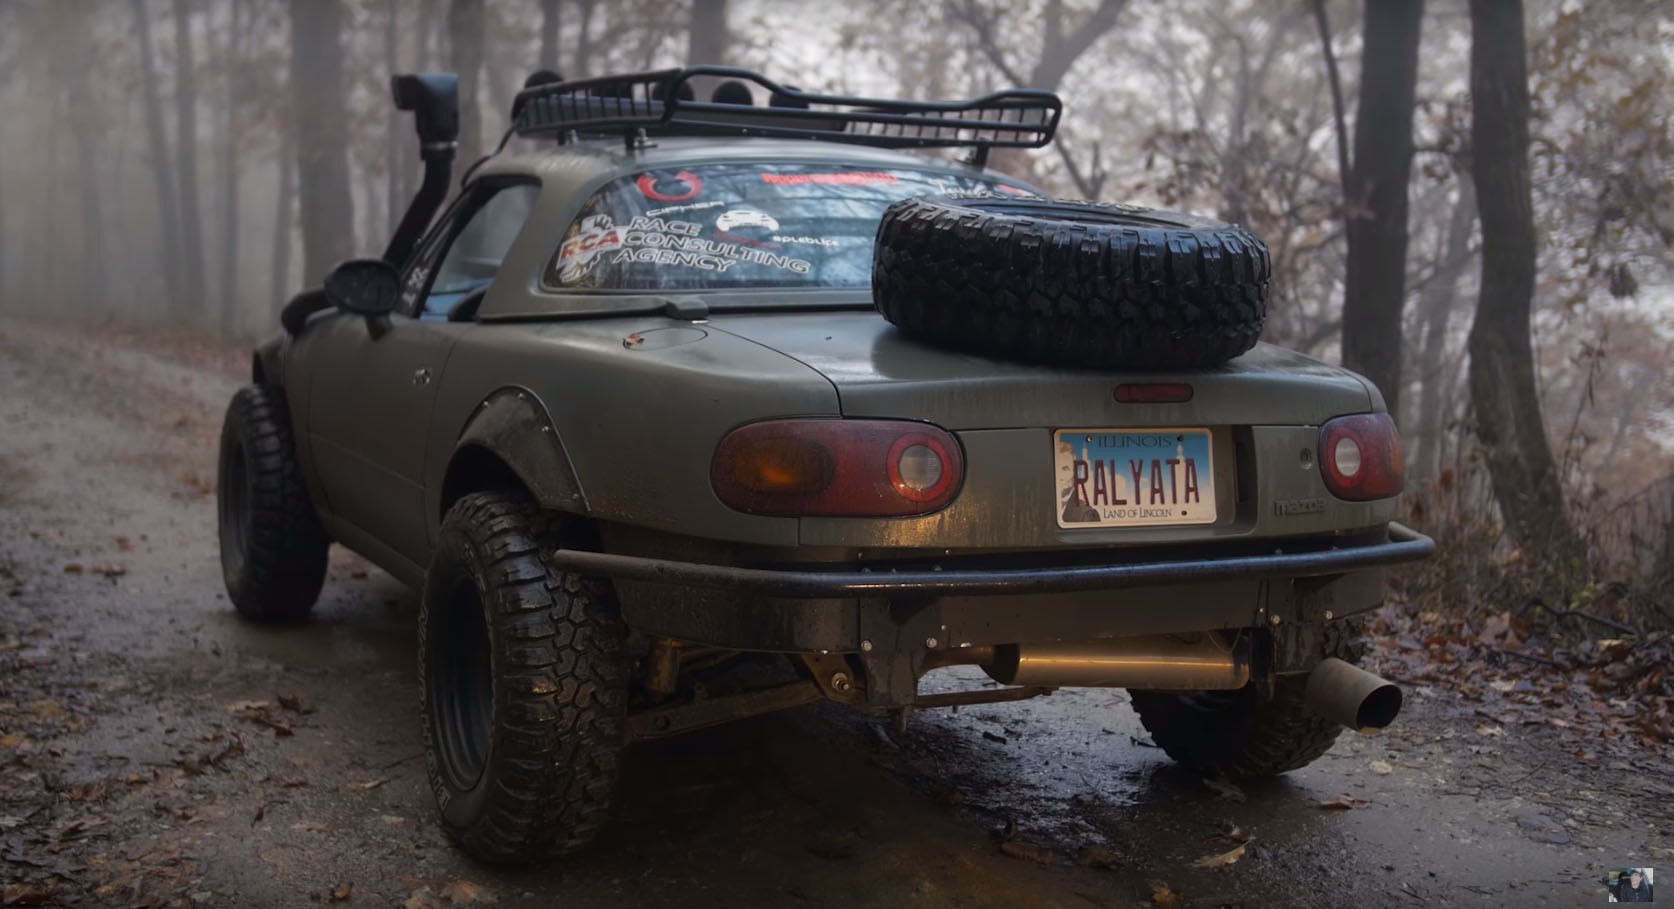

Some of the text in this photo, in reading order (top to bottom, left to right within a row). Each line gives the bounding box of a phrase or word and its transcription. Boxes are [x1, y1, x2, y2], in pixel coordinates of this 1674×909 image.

[630, 216, 702, 236] RACE
[612, 248, 736, 272] AGENCY
[623, 232, 811, 274] CONSULTING
[1098, 435, 1172, 448] ILLINOIS
[1073, 458, 1200, 507] RALYATA
